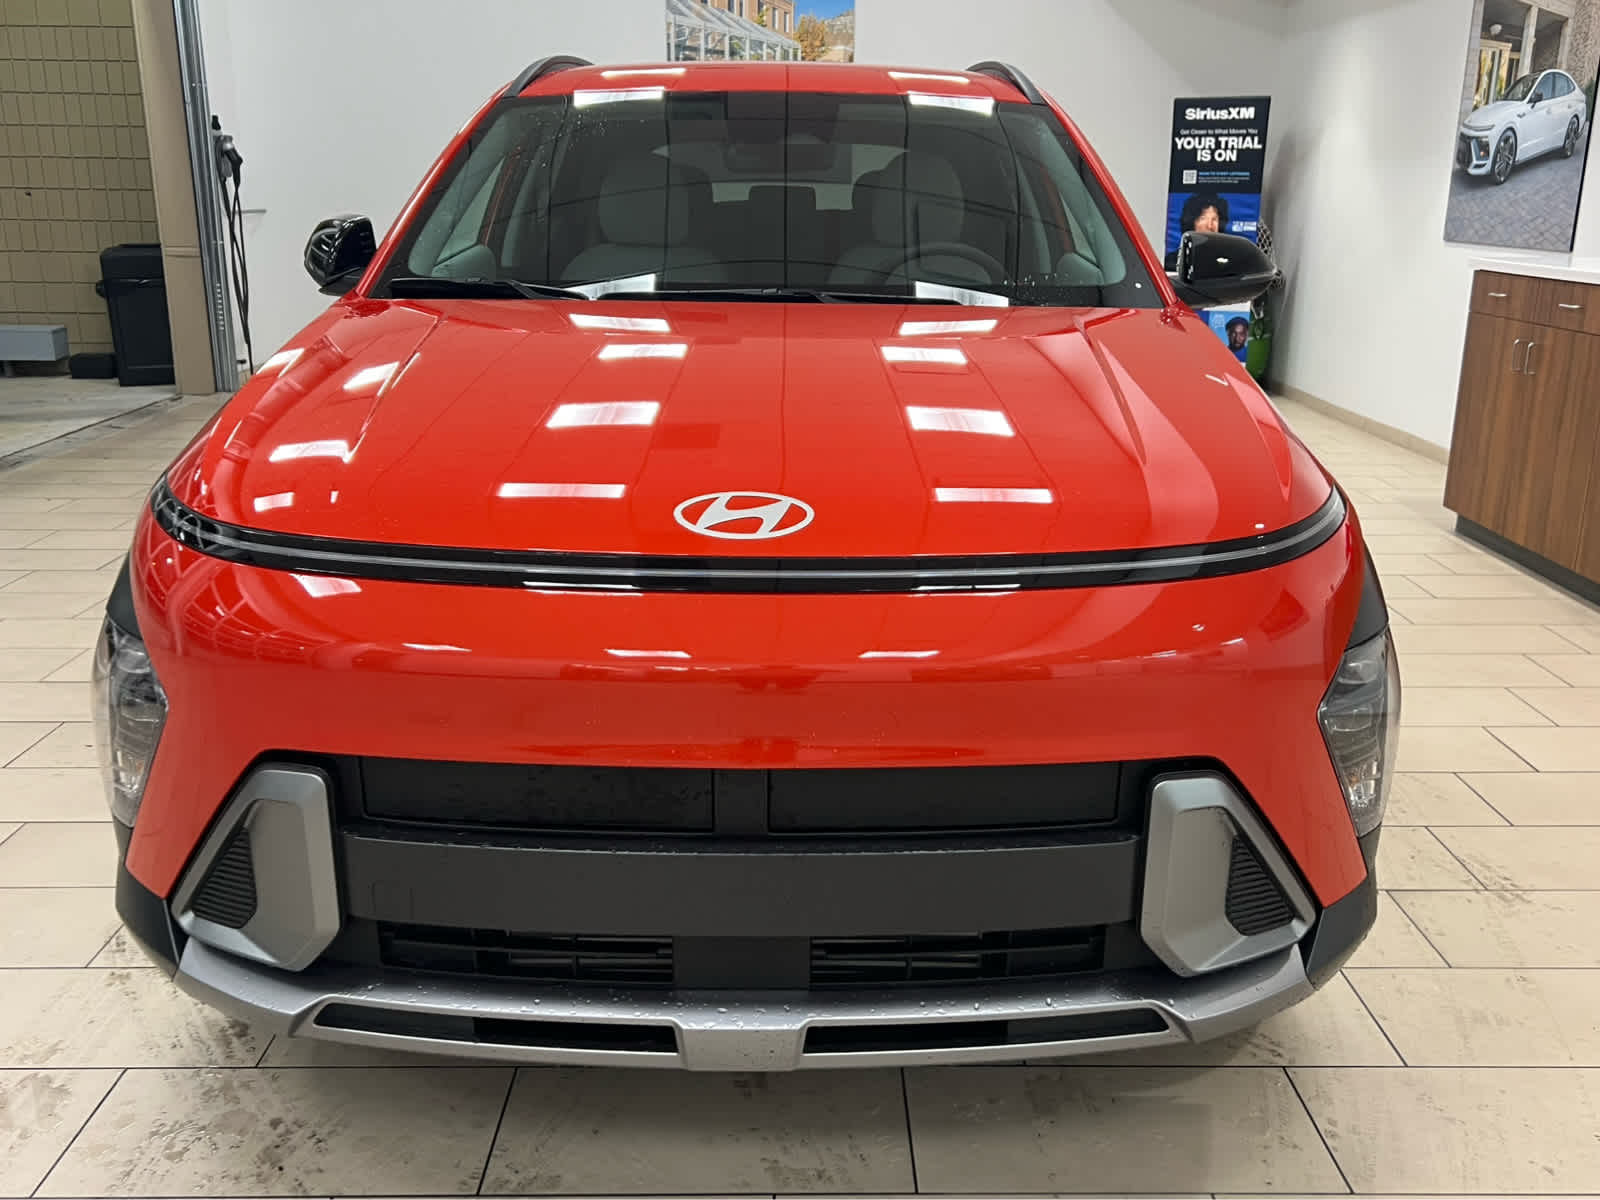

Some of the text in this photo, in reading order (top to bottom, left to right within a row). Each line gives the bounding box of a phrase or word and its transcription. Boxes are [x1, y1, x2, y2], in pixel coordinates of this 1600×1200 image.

[1185, 107, 1255, 120] SiriusXM
[1174, 136, 1263, 150] YOUR TRIAL
[1196, 149, 1238, 162] IS ON
